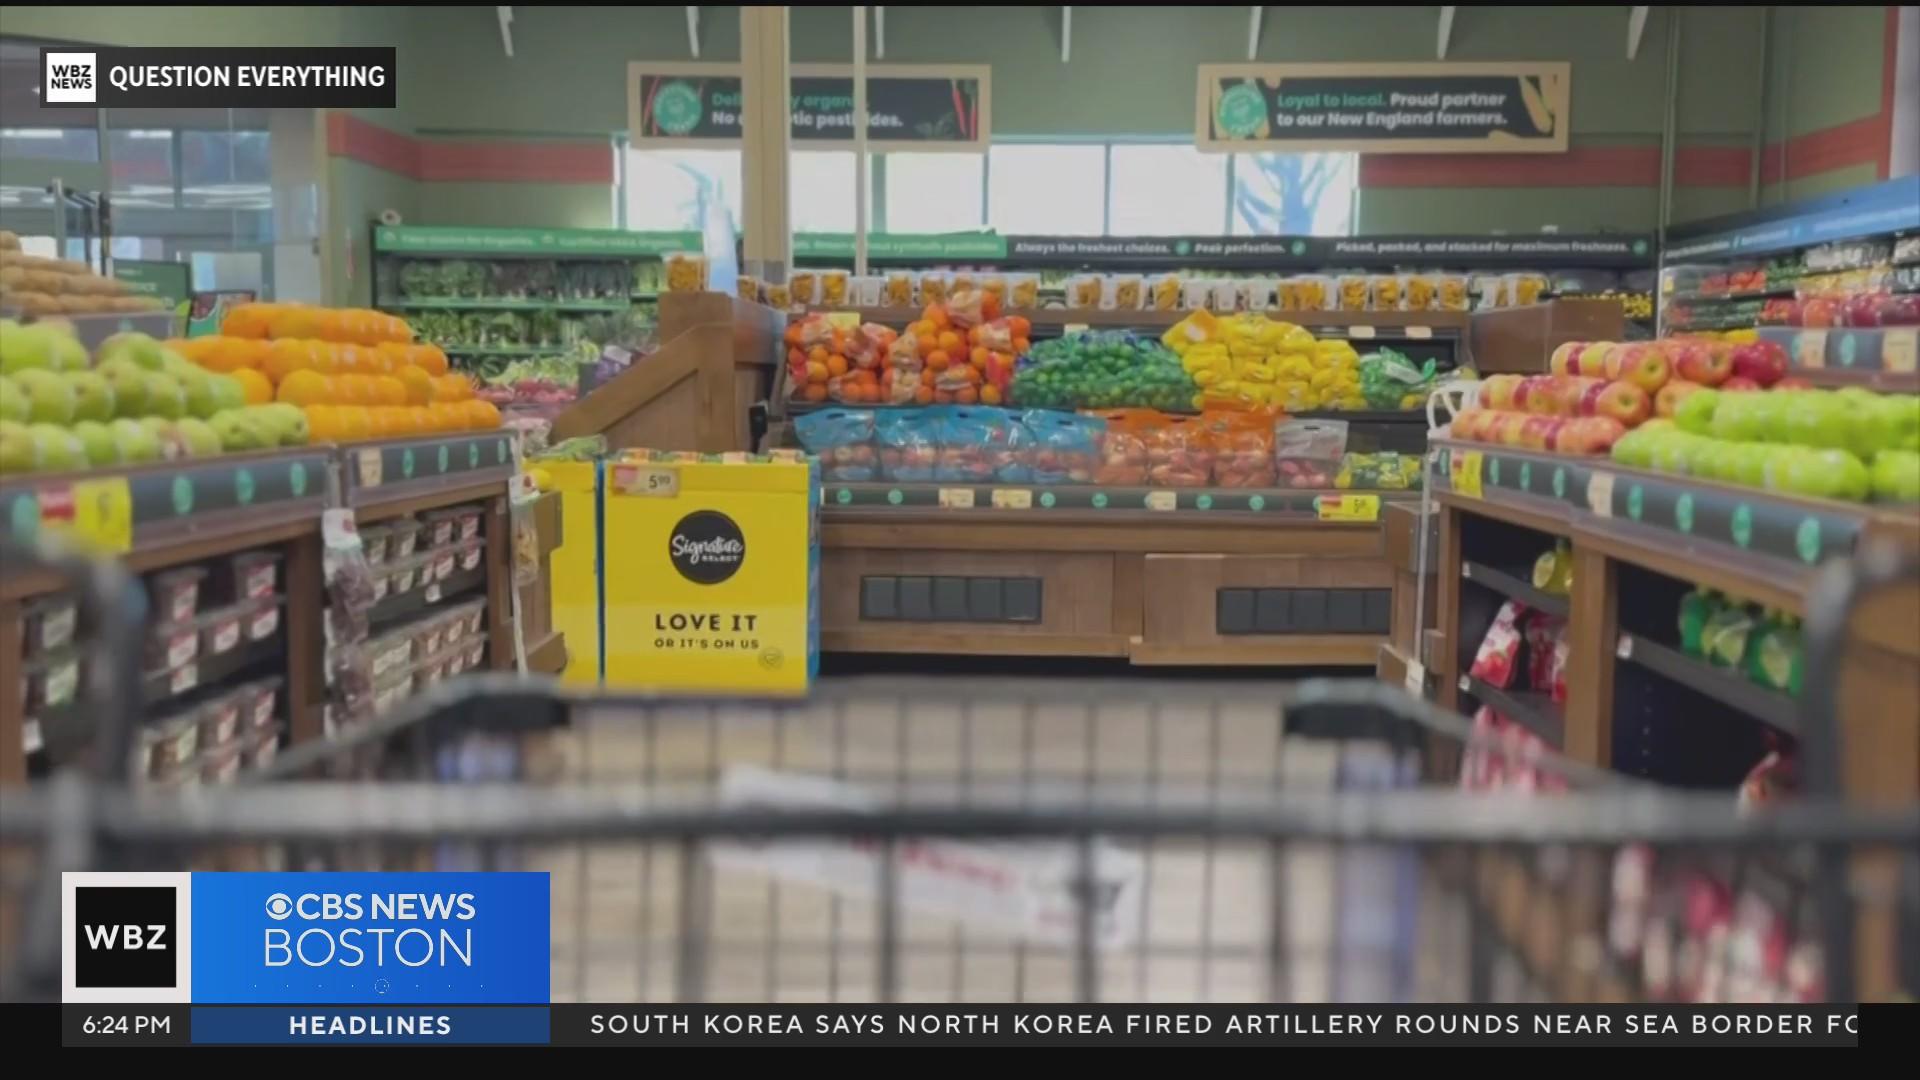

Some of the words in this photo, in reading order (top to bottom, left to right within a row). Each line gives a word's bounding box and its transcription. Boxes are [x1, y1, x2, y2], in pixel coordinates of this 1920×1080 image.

[1277, 93, 1320, 111] Loyal
[1324, 94, 1340, 107] to
[1343, 93, 1386, 107] local.
[1390, 92, 1439, 106] Proud
[1441, 92, 1506, 111] partner
[712, 111, 735, 124] No
[1276, 113, 1294, 126] to
[1296, 114, 1325, 126] our
[1328, 112, 1363, 126] New
[1366, 112, 1433, 130] England
[1436, 112, 1508, 125] farmers.
[1015, 242, 1056, 255] Always
[1057, 242, 1077, 253] the
[1078, 242, 1124, 253] freshest
[1194, 243, 1223, 253] Peak
[1424, 241, 1446, 252] and
[1494, 241, 1511, 252] for
[1511, 242, 1571, 252] maximum
[671, 533, 744, 566] Signature
[655, 613, 721, 632] LOVE
[731, 614, 758, 632] IT
[653, 637, 675, 649] OR
[680, 638, 709, 649] IT'S
[713, 638, 735, 650] ON
[740, 639, 760, 650] US
